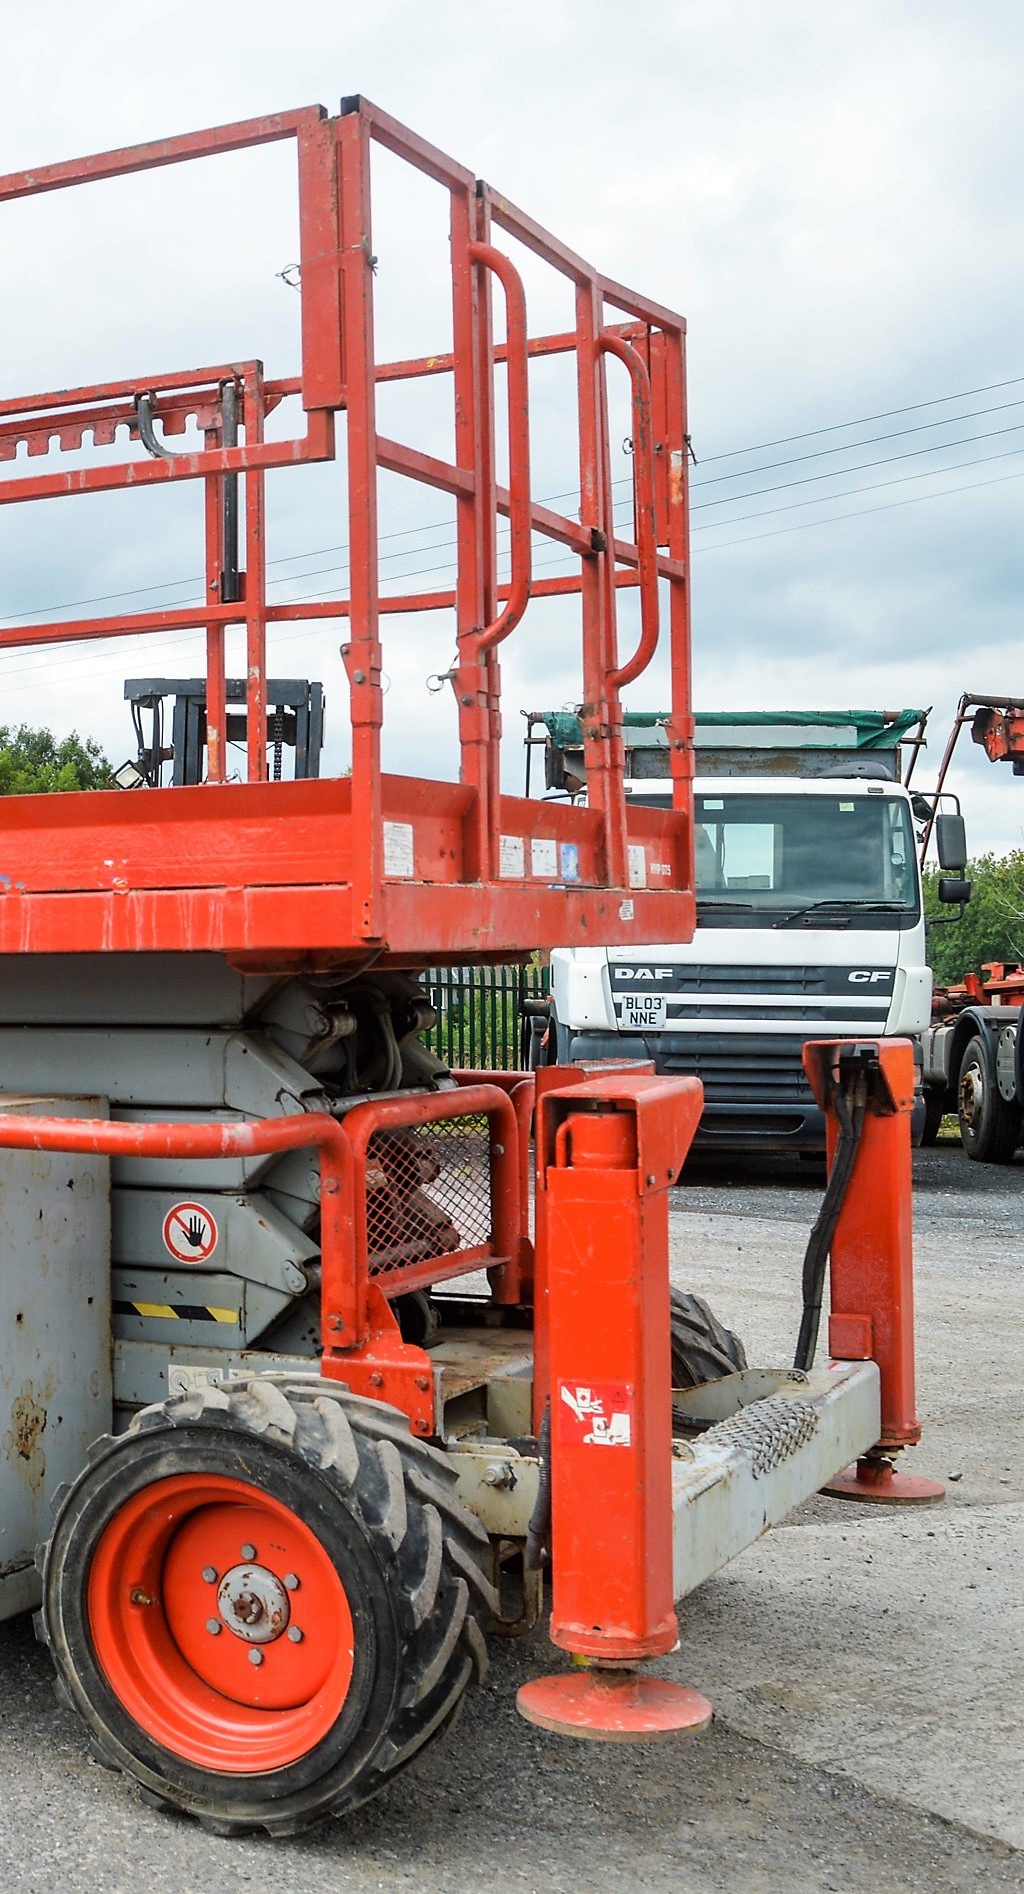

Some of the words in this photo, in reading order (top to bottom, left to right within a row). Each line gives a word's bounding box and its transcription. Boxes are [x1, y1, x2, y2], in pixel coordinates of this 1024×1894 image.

[614, 968, 673, 980] DAF
[848, 971, 892, 983] CF
[626, 997, 662, 1010] BL03
[630, 1012, 657, 1024] NNE
